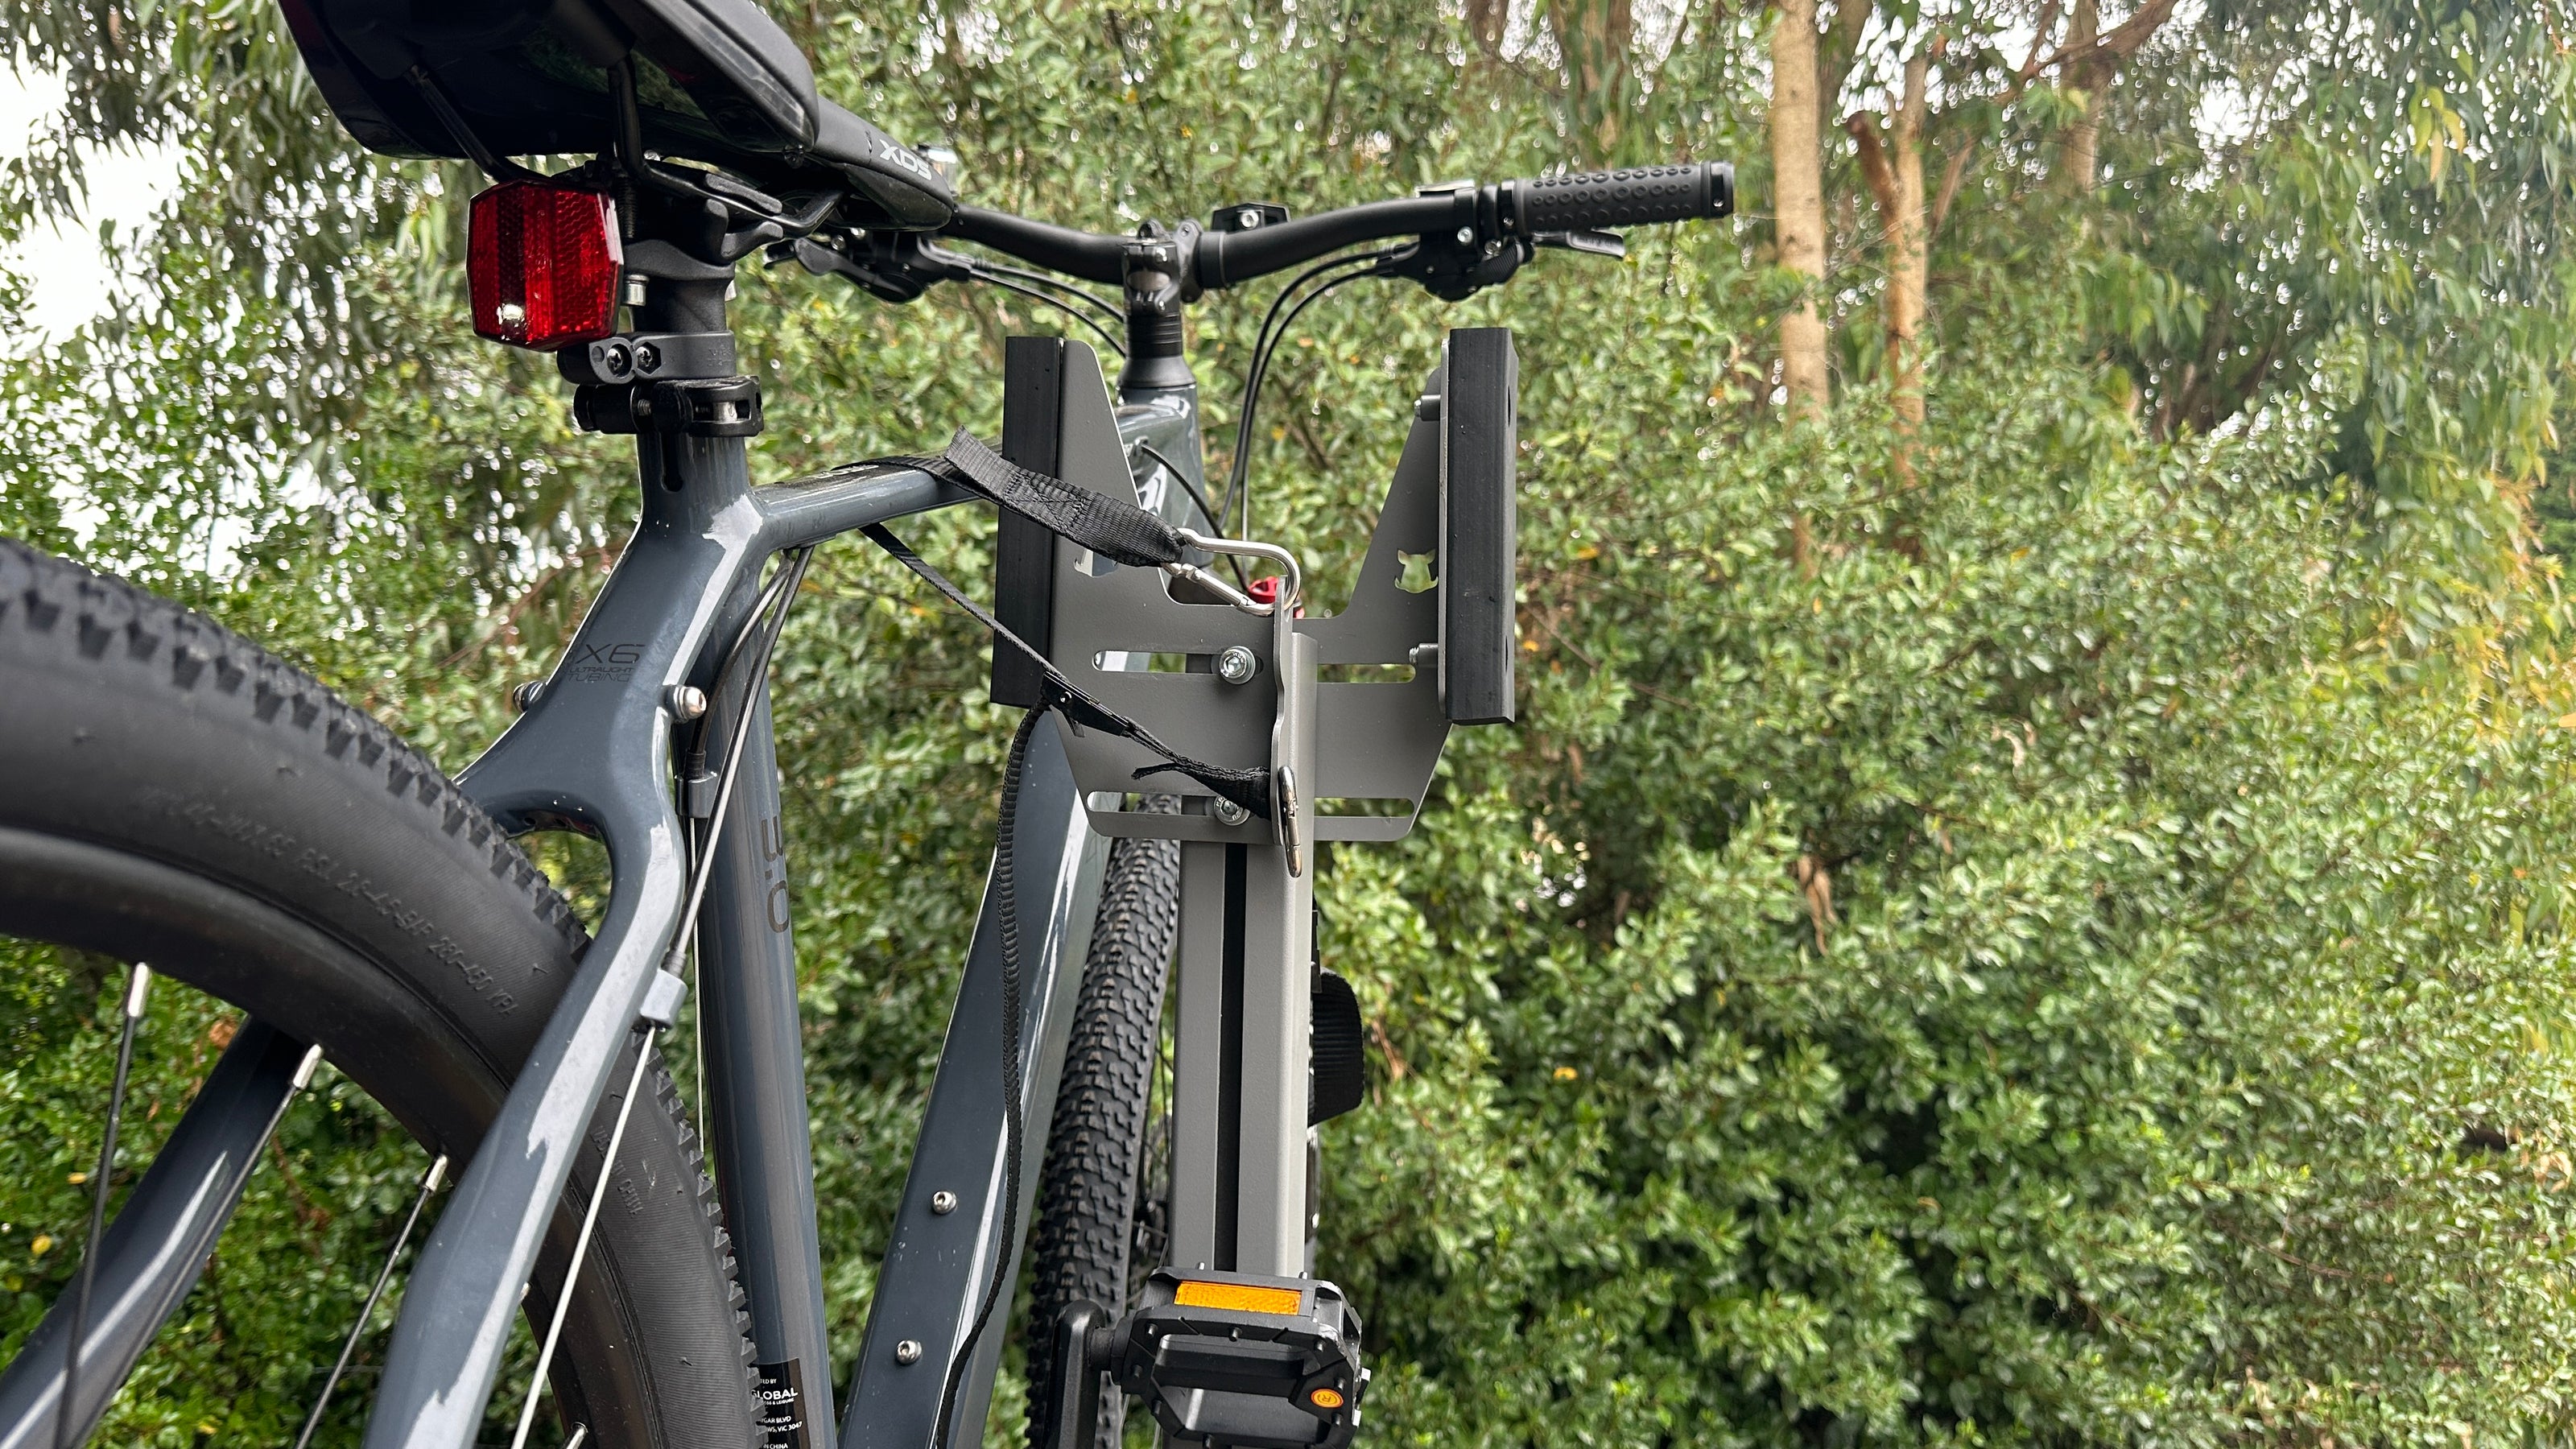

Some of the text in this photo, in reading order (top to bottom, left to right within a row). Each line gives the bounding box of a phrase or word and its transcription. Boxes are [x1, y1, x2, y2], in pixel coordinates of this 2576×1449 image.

[879, 138, 932, 180] XDS
[575, 644, 645, 664] X6
[568, 674, 631, 683] TUBING
[751, 1387, 799, 1400] GLOBAL
[776, 1415, 791, 1423] BLVD
[788, 1421, 803, 1430] 3047
